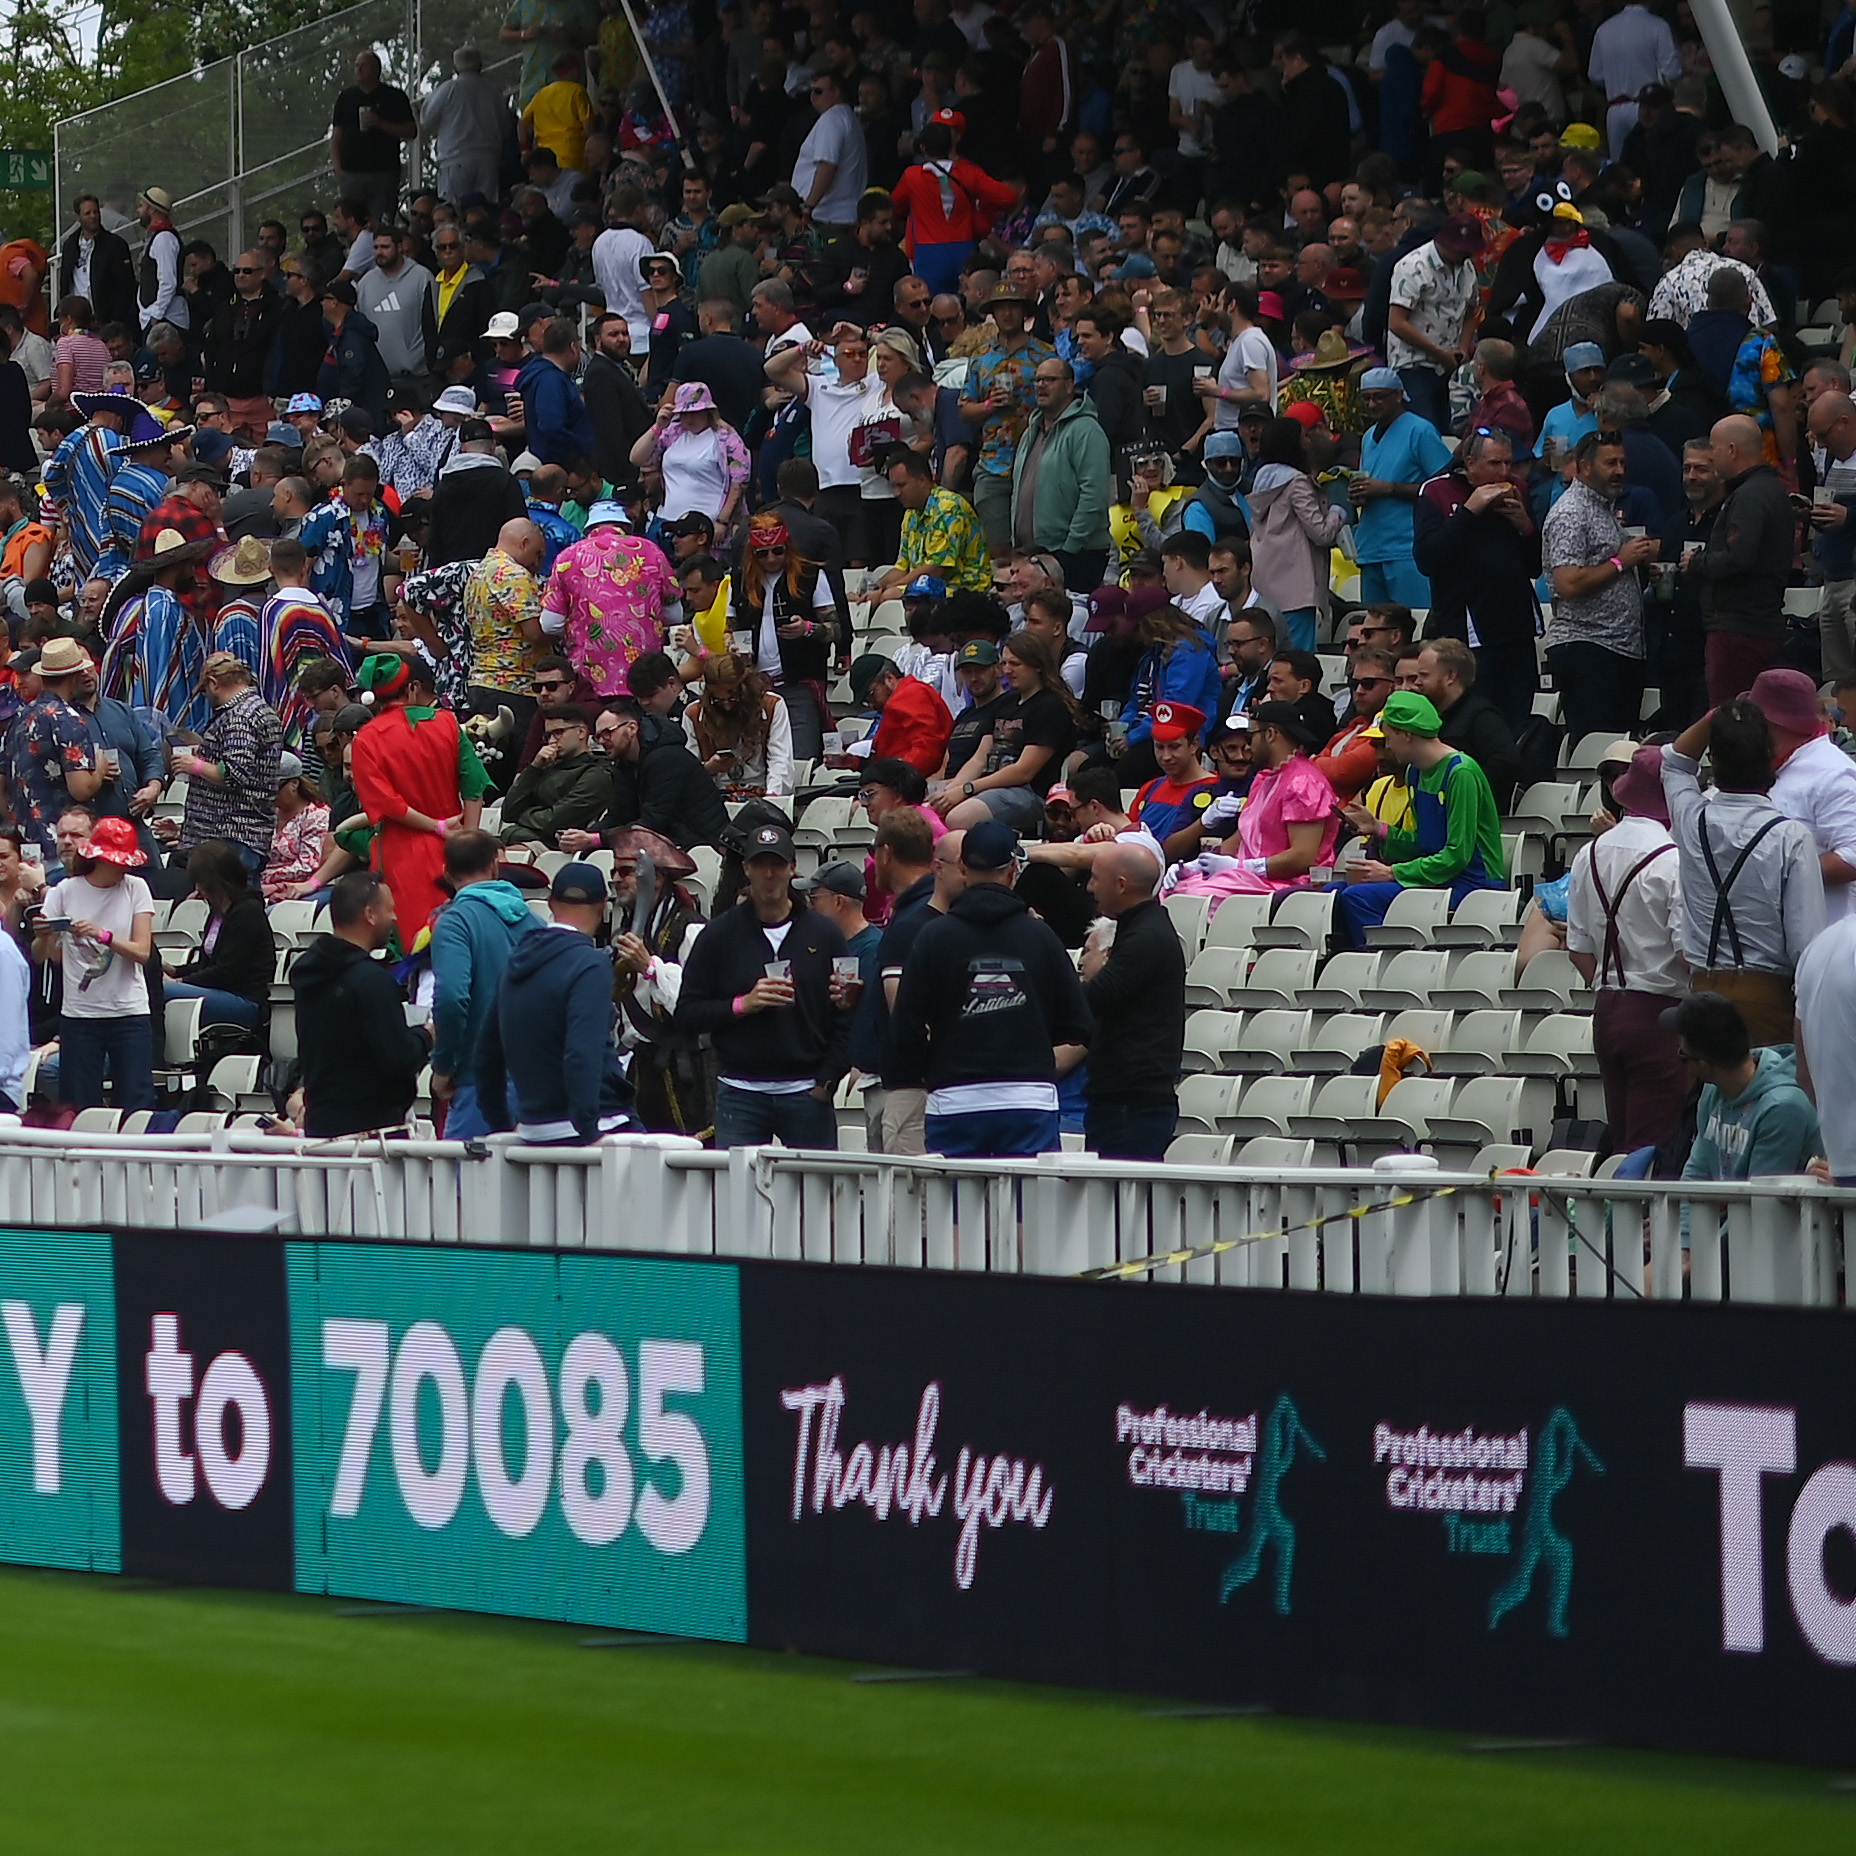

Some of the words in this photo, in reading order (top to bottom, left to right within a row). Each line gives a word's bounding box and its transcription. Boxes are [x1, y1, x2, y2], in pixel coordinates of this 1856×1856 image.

[961, 987, 1028, 1018] Latitude
[147, 1314, 270, 1510] to
[322, 1317, 711, 1554] 70085
[780, 1377, 948, 1527] Thank
[952, 1446, 1054, 1590] you
[1117, 1405, 1257, 1453] Professional
[1374, 1424, 1530, 1470] Professional
[1130, 1445, 1252, 1493] Cricketers'
[1387, 1466, 1524, 1513] Cricketers'
[1181, 1490, 1240, 1533] Trust
[1444, 1512, 1511, 1554] Trust
[1683, 1403, 1856, 1665] To
